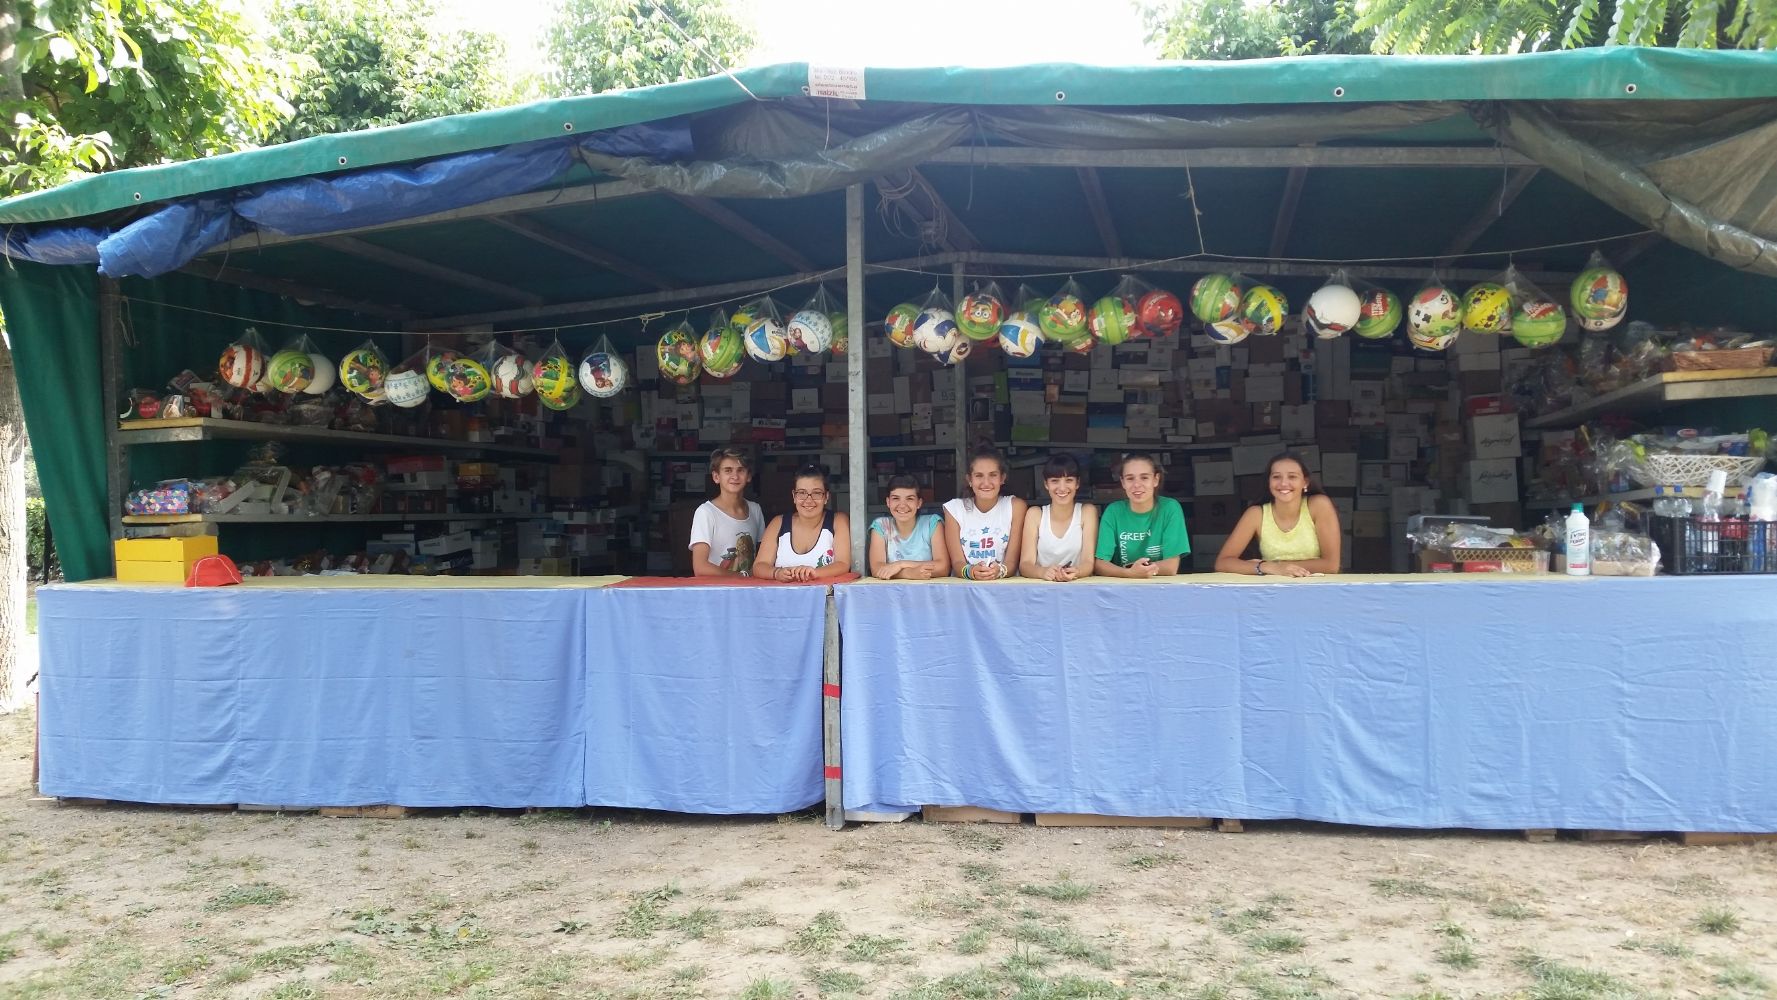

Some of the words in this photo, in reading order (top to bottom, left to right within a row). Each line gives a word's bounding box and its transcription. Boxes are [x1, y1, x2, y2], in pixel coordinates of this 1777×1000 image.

[1120, 530, 1151, 541] GREEN
[980, 537, 994, 549] 15
[967, 549, 996, 559] ANNI
